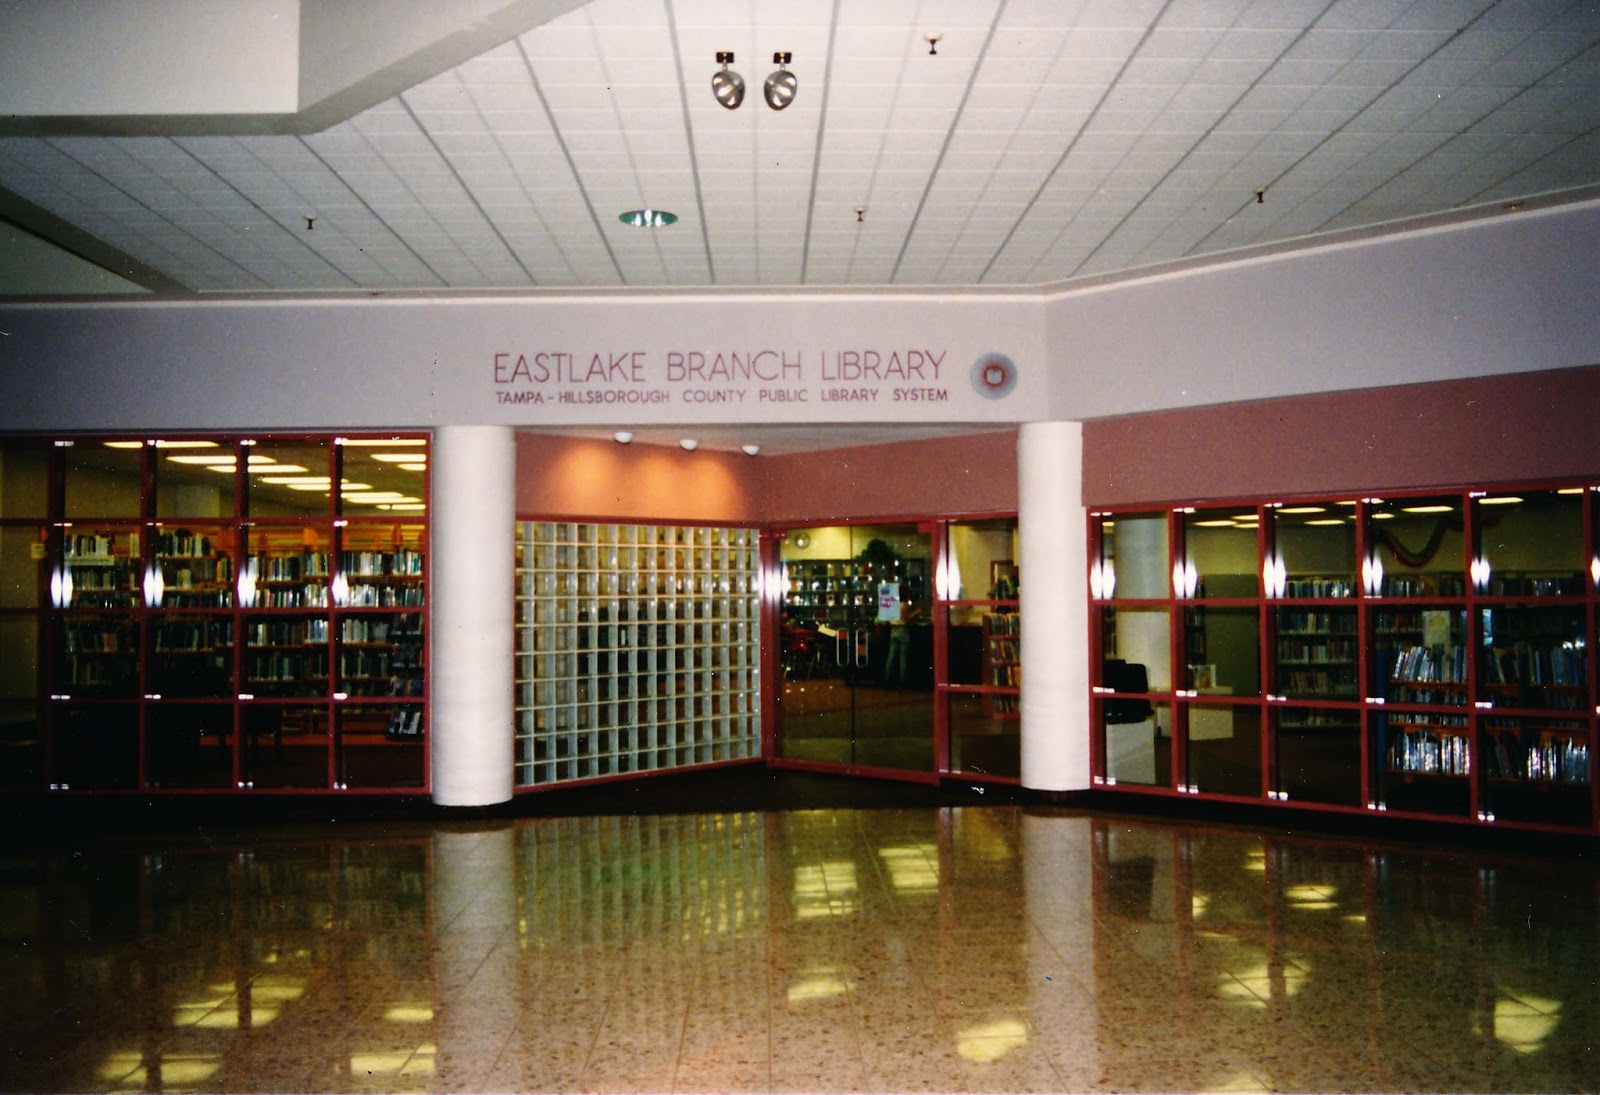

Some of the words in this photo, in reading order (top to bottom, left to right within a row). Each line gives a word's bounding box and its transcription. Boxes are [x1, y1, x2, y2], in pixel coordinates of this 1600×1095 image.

[494, 352, 646, 383] EASTLAKE
[667, 350, 801, 381] BRANCH
[822, 350, 947, 380] LIBRARY
[683, 389, 746, 403] COUNTY
[760, 388, 808, 403] PUBLIC
[821, 388, 878, 402] LIBRARY
[893, 387, 948, 402] SYSTEM
